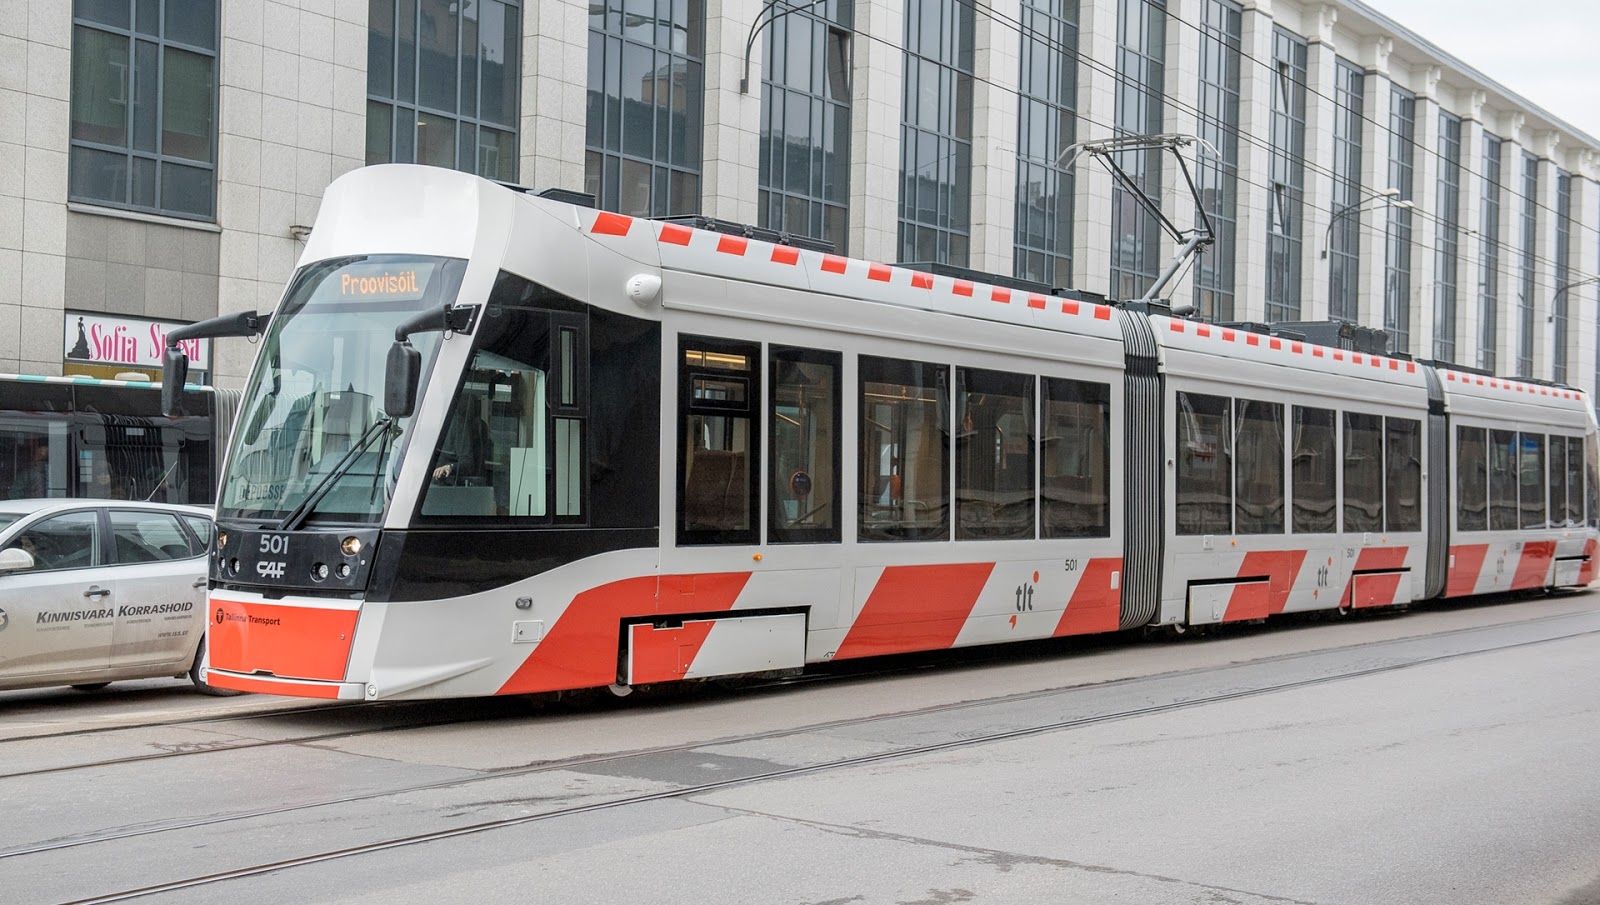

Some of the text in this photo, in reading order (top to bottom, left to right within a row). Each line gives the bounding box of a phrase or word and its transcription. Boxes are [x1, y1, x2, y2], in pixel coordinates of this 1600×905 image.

[90, 322, 200, 365] Sofia Spsa
[259, 534, 289, 554] 501
[256, 561, 287, 578] CAF
[1064, 559, 1078, 571] 501
[1317, 565, 1329, 587] tlt
[1015, 582, 1034, 612] tlt
[36, 608, 114, 624] KINNISVARA
[118, 602, 193, 617] KORRASHOID
[225, 613, 281, 626] Tallinna Transport
